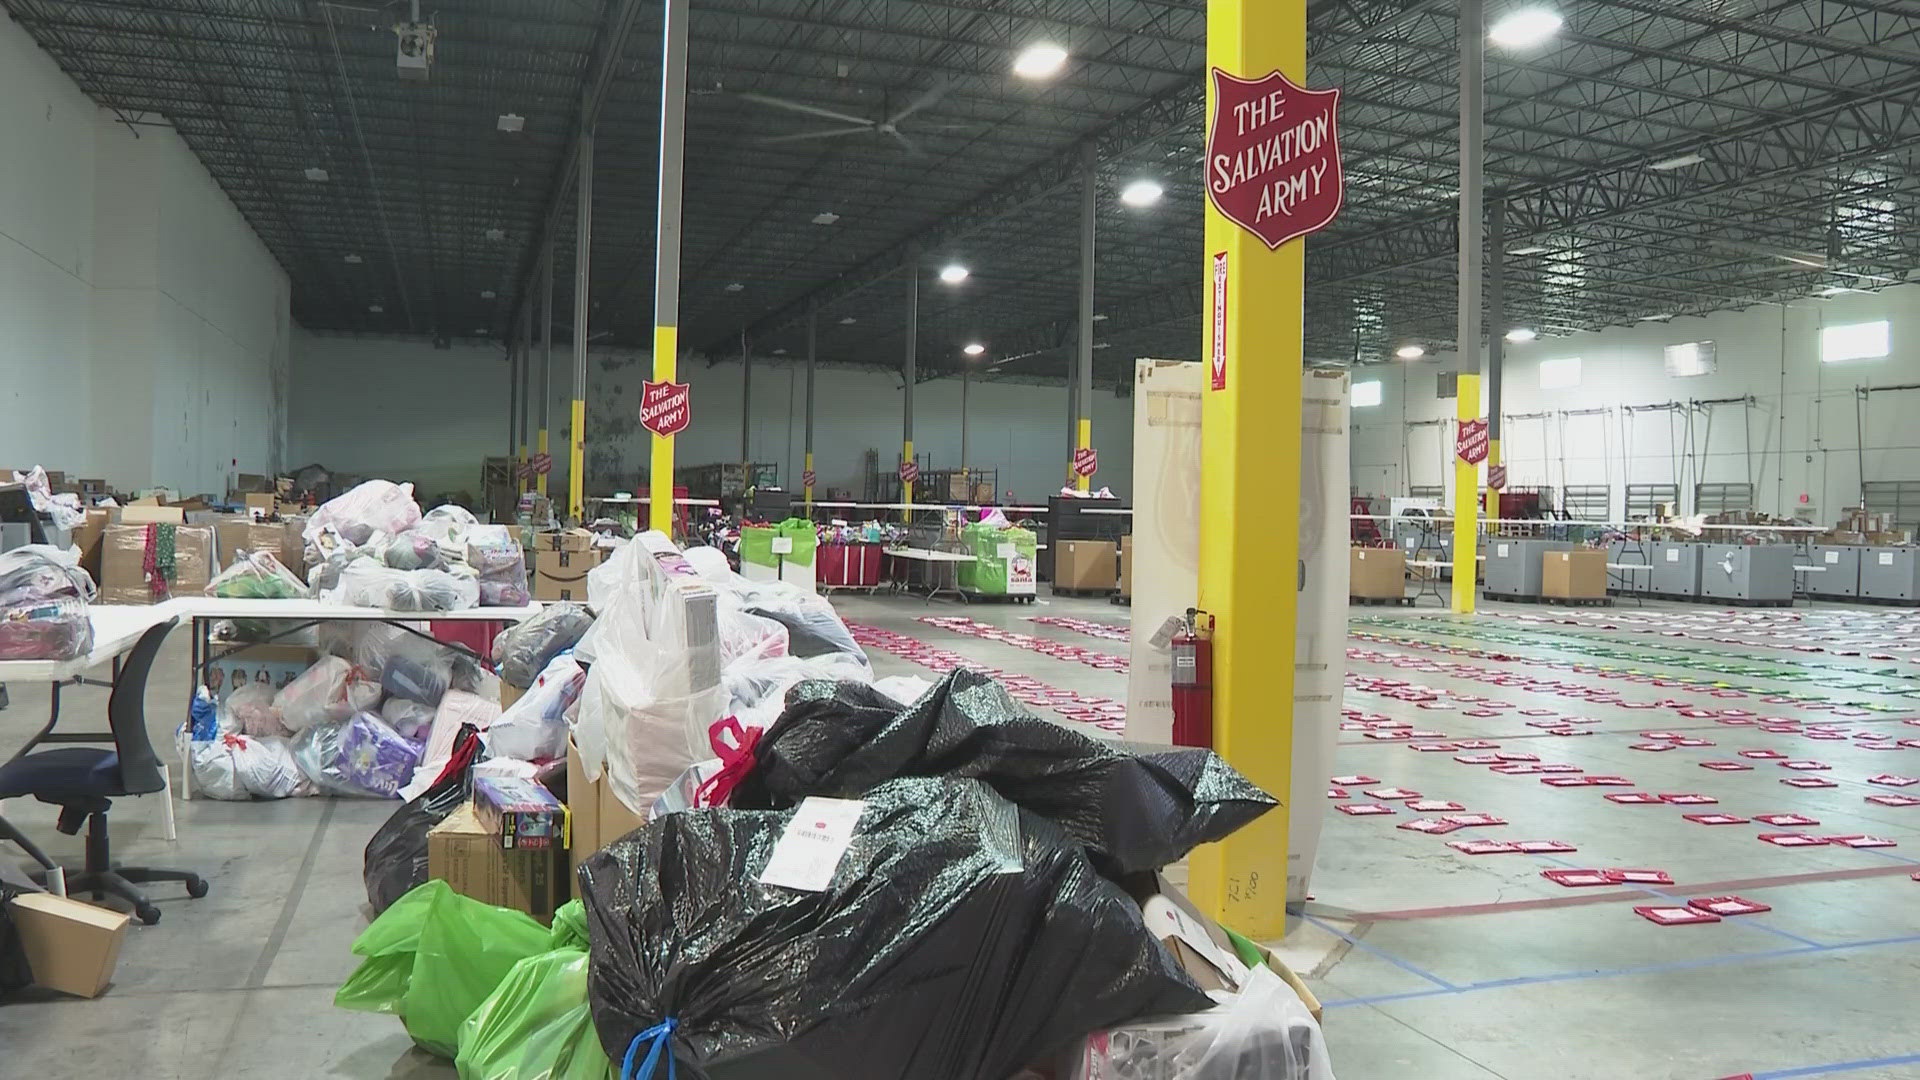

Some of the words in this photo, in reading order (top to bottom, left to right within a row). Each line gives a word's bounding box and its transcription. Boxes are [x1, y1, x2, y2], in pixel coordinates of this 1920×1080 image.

[1233, 89, 1286, 137] THE
[1212, 108, 1329, 194] SALVATION
[1255, 157, 1328, 224] ARMY
[1214, 261, 1226, 276] FIRE
[642, 390, 686, 422] SALVATION
[649, 385, 670, 403] THE
[656, 406, 685, 431] ARMY
[1462, 422, 1477, 438] THE
[1456, 427, 1487, 454] SALVATION
[1467, 440, 1487, 461] ARMY
